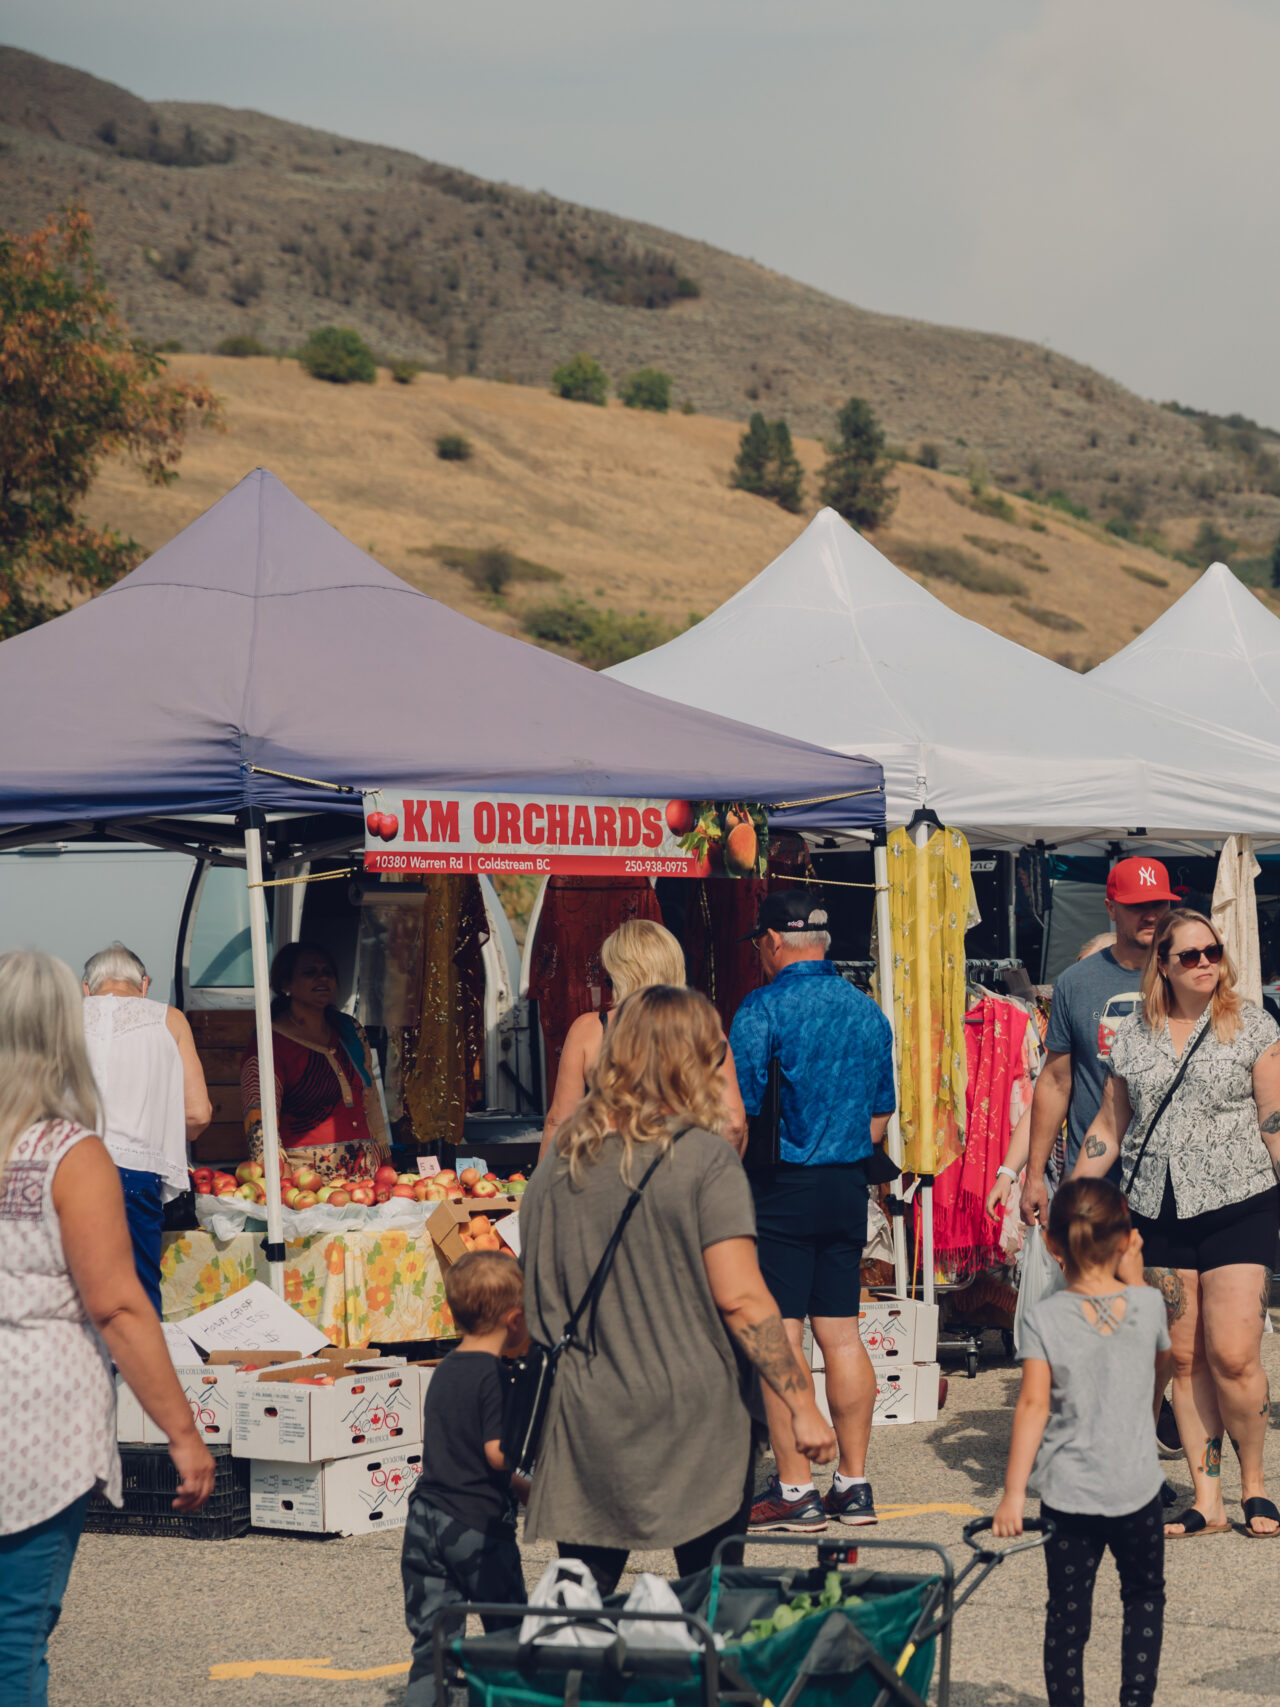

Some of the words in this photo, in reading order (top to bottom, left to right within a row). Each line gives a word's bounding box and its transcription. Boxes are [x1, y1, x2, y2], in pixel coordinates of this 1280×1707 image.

[402, 799, 460, 842] KM
[473, 801, 664, 848] ORCHARDS
[375, 855, 407, 868] 10380
[410, 856, 446, 869] Warren
[450, 857, 463, 869] Rd
[477, 857, 533, 870] Coldstream
[536, 858, 550, 870] BC
[625, 860, 688, 873] 250-938-0975
[1138, 866, 1157, 886] NY
[230, 1298, 253, 1320] CRISP
[217, 1310, 270, 1342] APPLES
